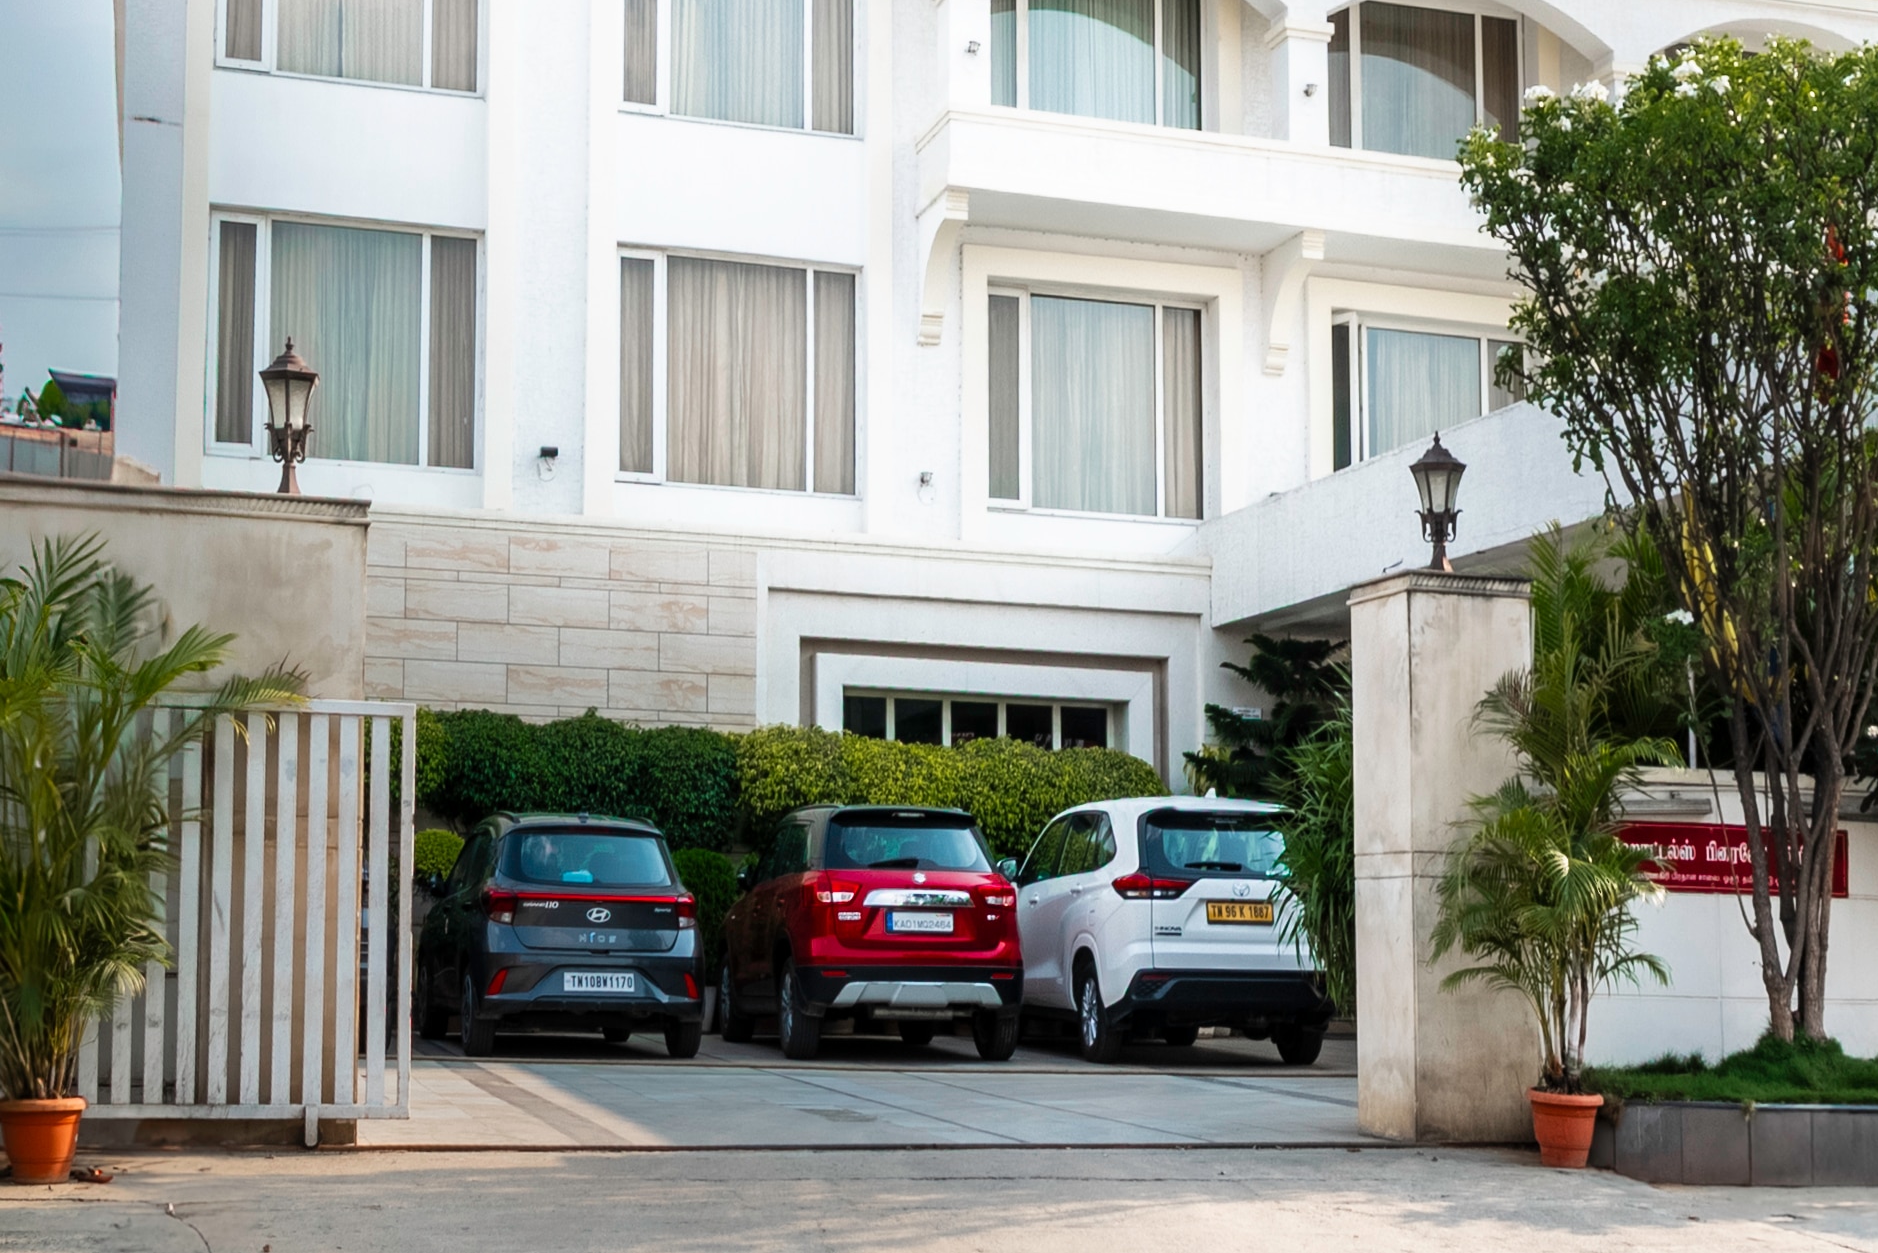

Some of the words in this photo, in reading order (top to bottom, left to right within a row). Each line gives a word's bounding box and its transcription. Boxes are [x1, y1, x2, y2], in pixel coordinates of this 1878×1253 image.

[1211, 905, 1223, 918] TN
[1225, 905, 1237, 918] 96
[1238, 905, 1246, 918] K
[571, 975, 633, 988] TN10BW1170
